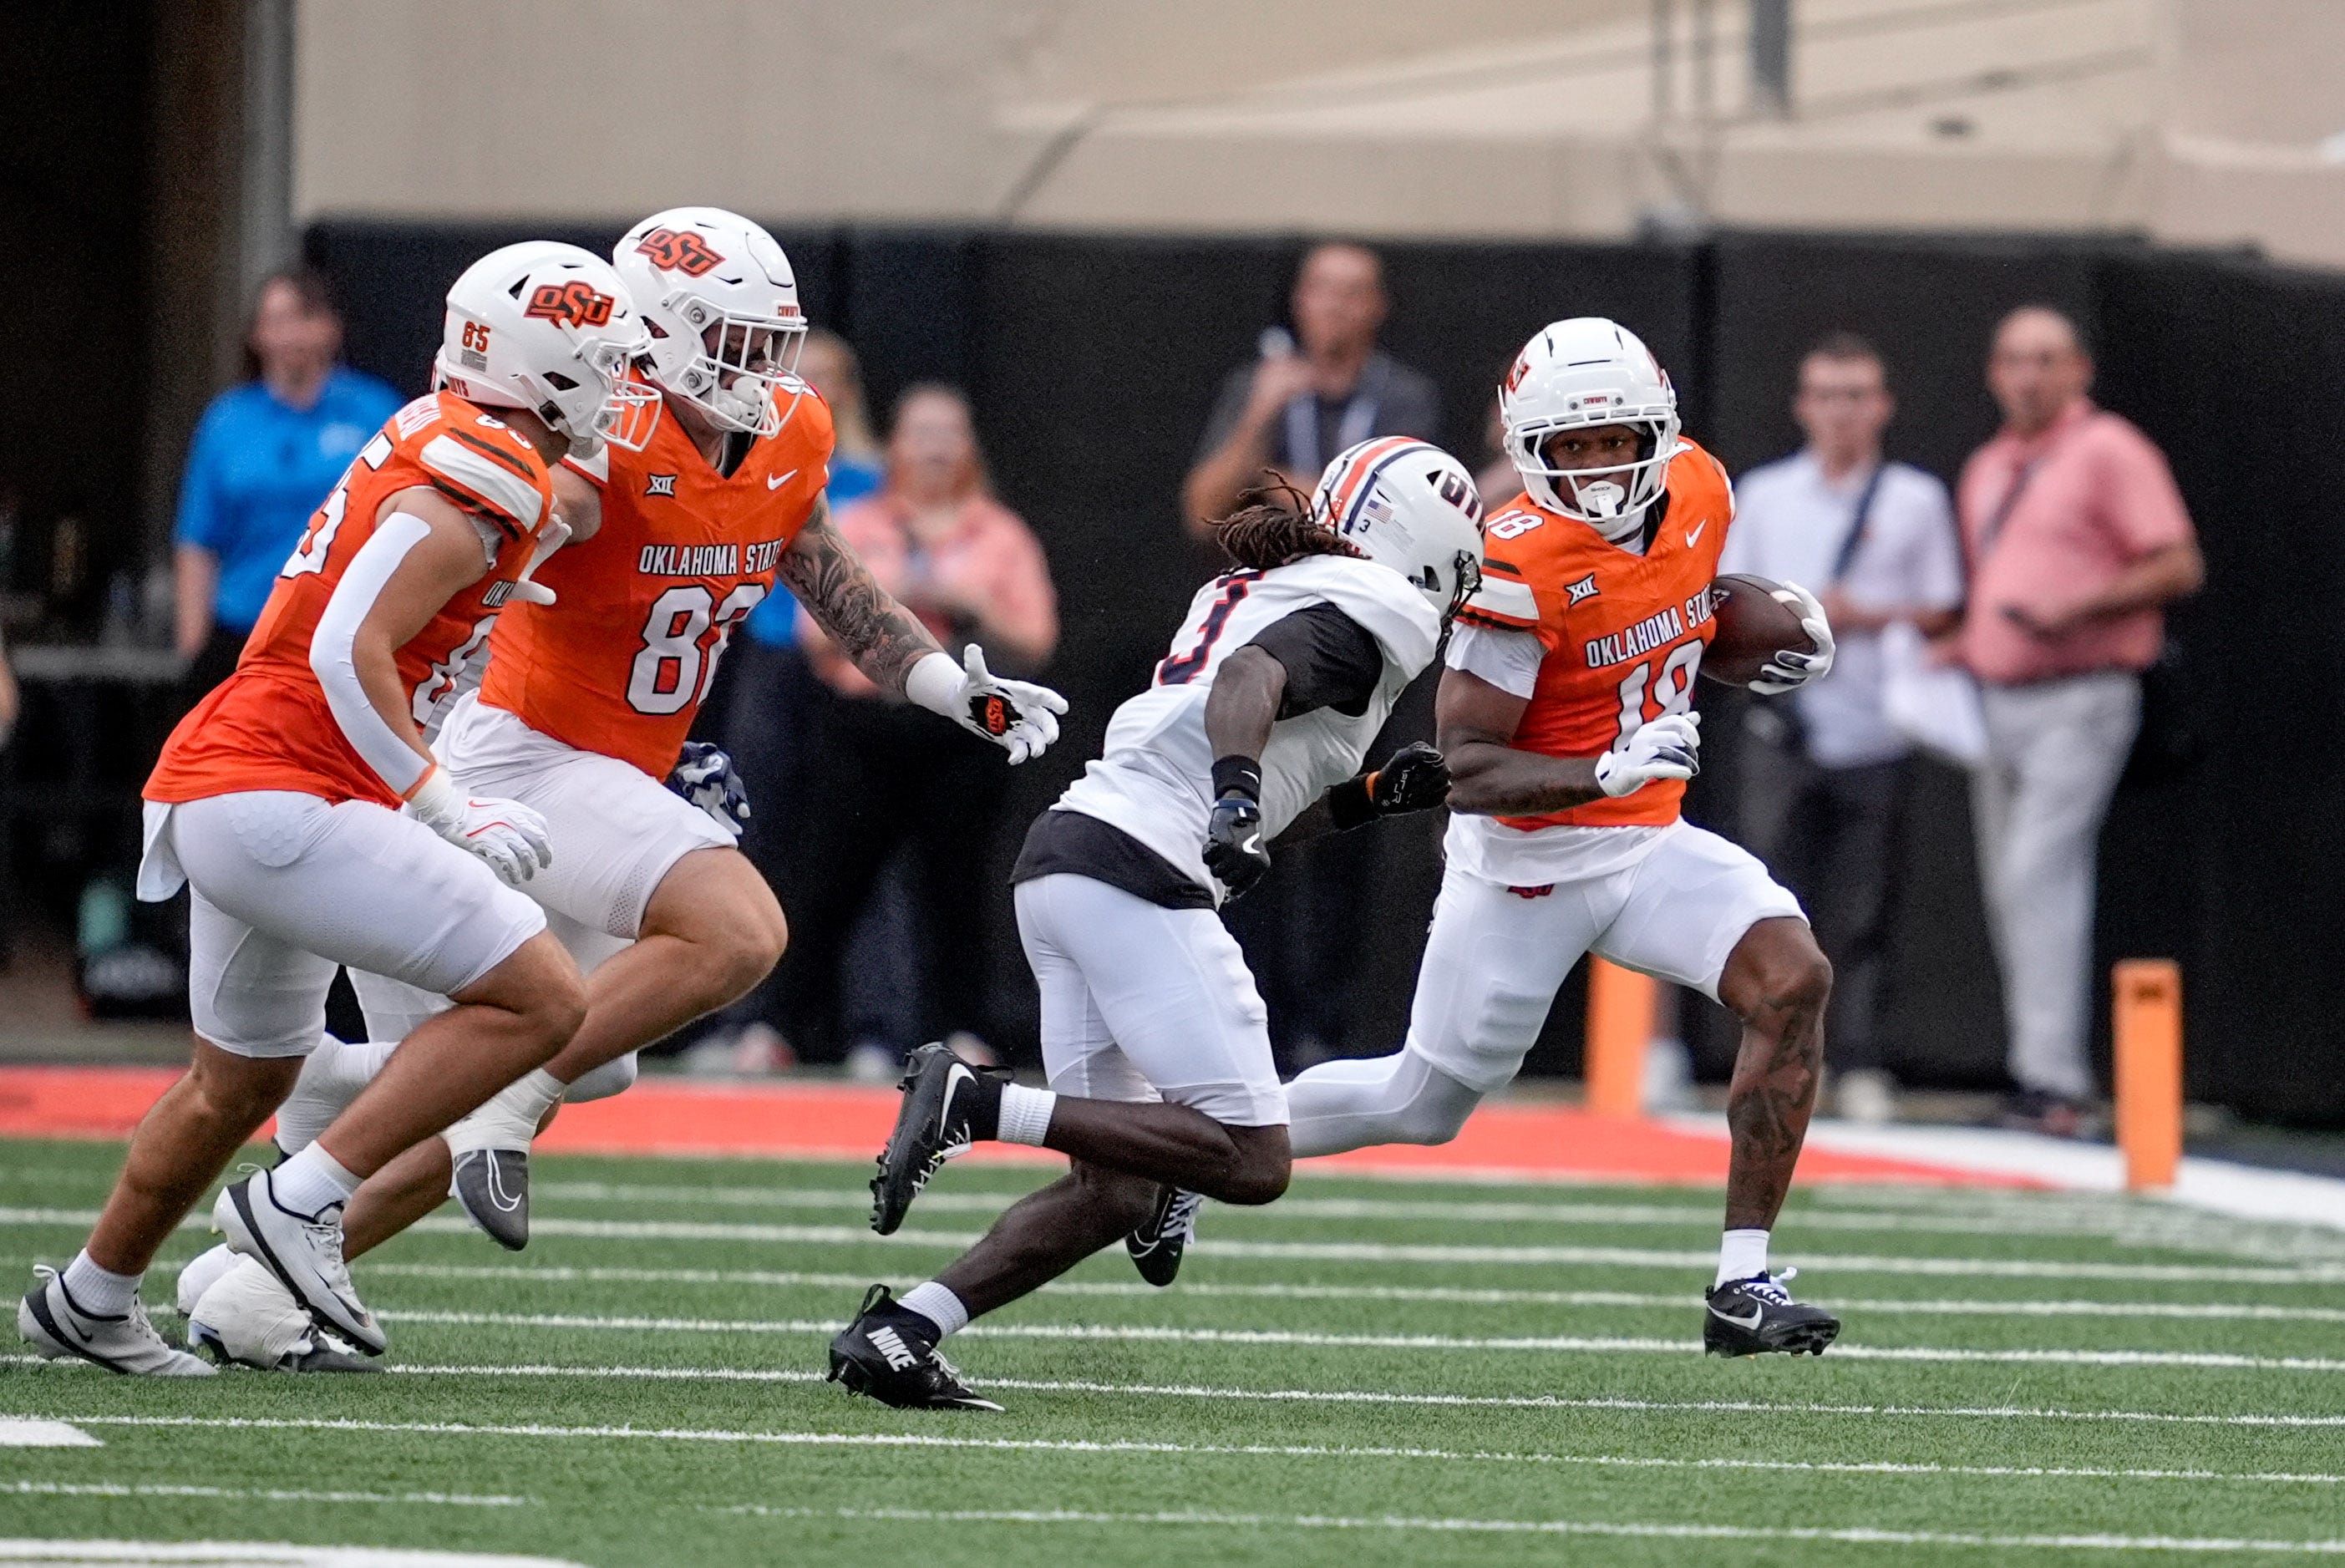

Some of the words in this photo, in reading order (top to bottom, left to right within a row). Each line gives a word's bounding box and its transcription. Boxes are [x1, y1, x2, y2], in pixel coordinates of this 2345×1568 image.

[635, 228, 727, 278] OSU
[524, 280, 615, 328] OSU
[462, 321, 491, 353] 85
[1358, 518, 1372, 533] 3
[638, 545, 739, 576] OKLAHOMA
[1586, 606, 1685, 669] OKLAHOMA
[1685, 582, 1713, 630] STA
[865, 1325, 918, 1373] NIKE
